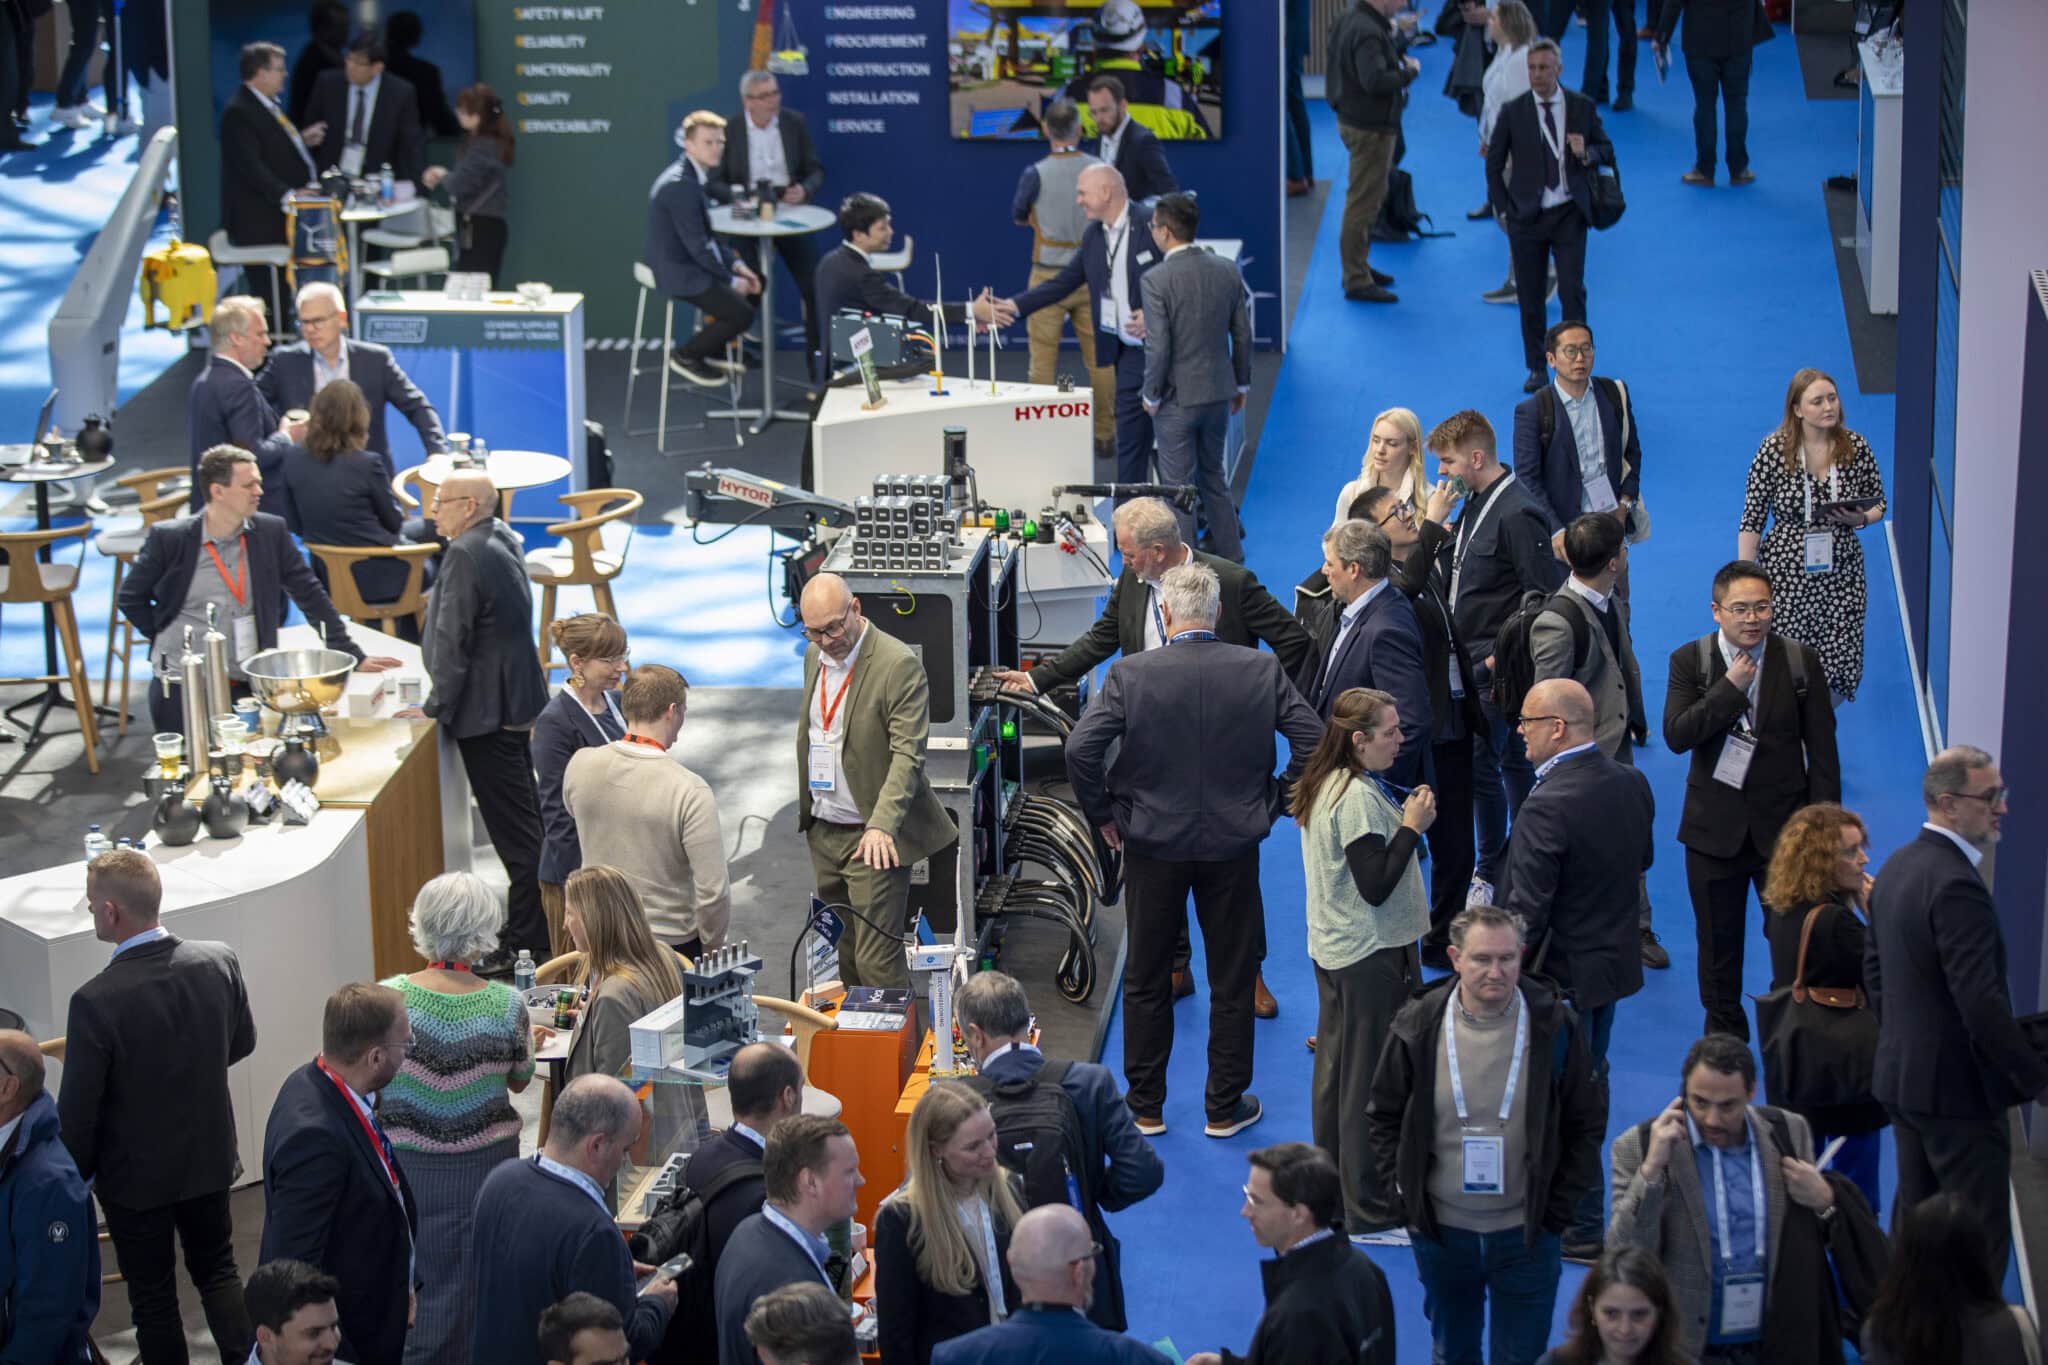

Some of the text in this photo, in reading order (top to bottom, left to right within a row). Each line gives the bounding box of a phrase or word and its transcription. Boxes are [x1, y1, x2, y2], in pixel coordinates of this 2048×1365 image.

[514, 6, 604, 20] SAFETY IN LIFT
[824, 6, 916, 19] ENGINEERING
[515, 35, 586, 48] RELIABILITY
[825, 34, 927, 48] PROCUREMENT
[516, 63, 611, 77] FUNCTIONALITY
[825, 63, 930, 77] CONSTRUCTION
[517, 92, 570, 107] QUALITY
[827, 91, 920, 104] INSTALLATION
[519, 120, 610, 133] SERVICEABILITY
[828, 120, 885, 133] SERVICE
[1015, 402, 1090, 421] HYTOR
[720, 479, 769, 503] HYTOR
